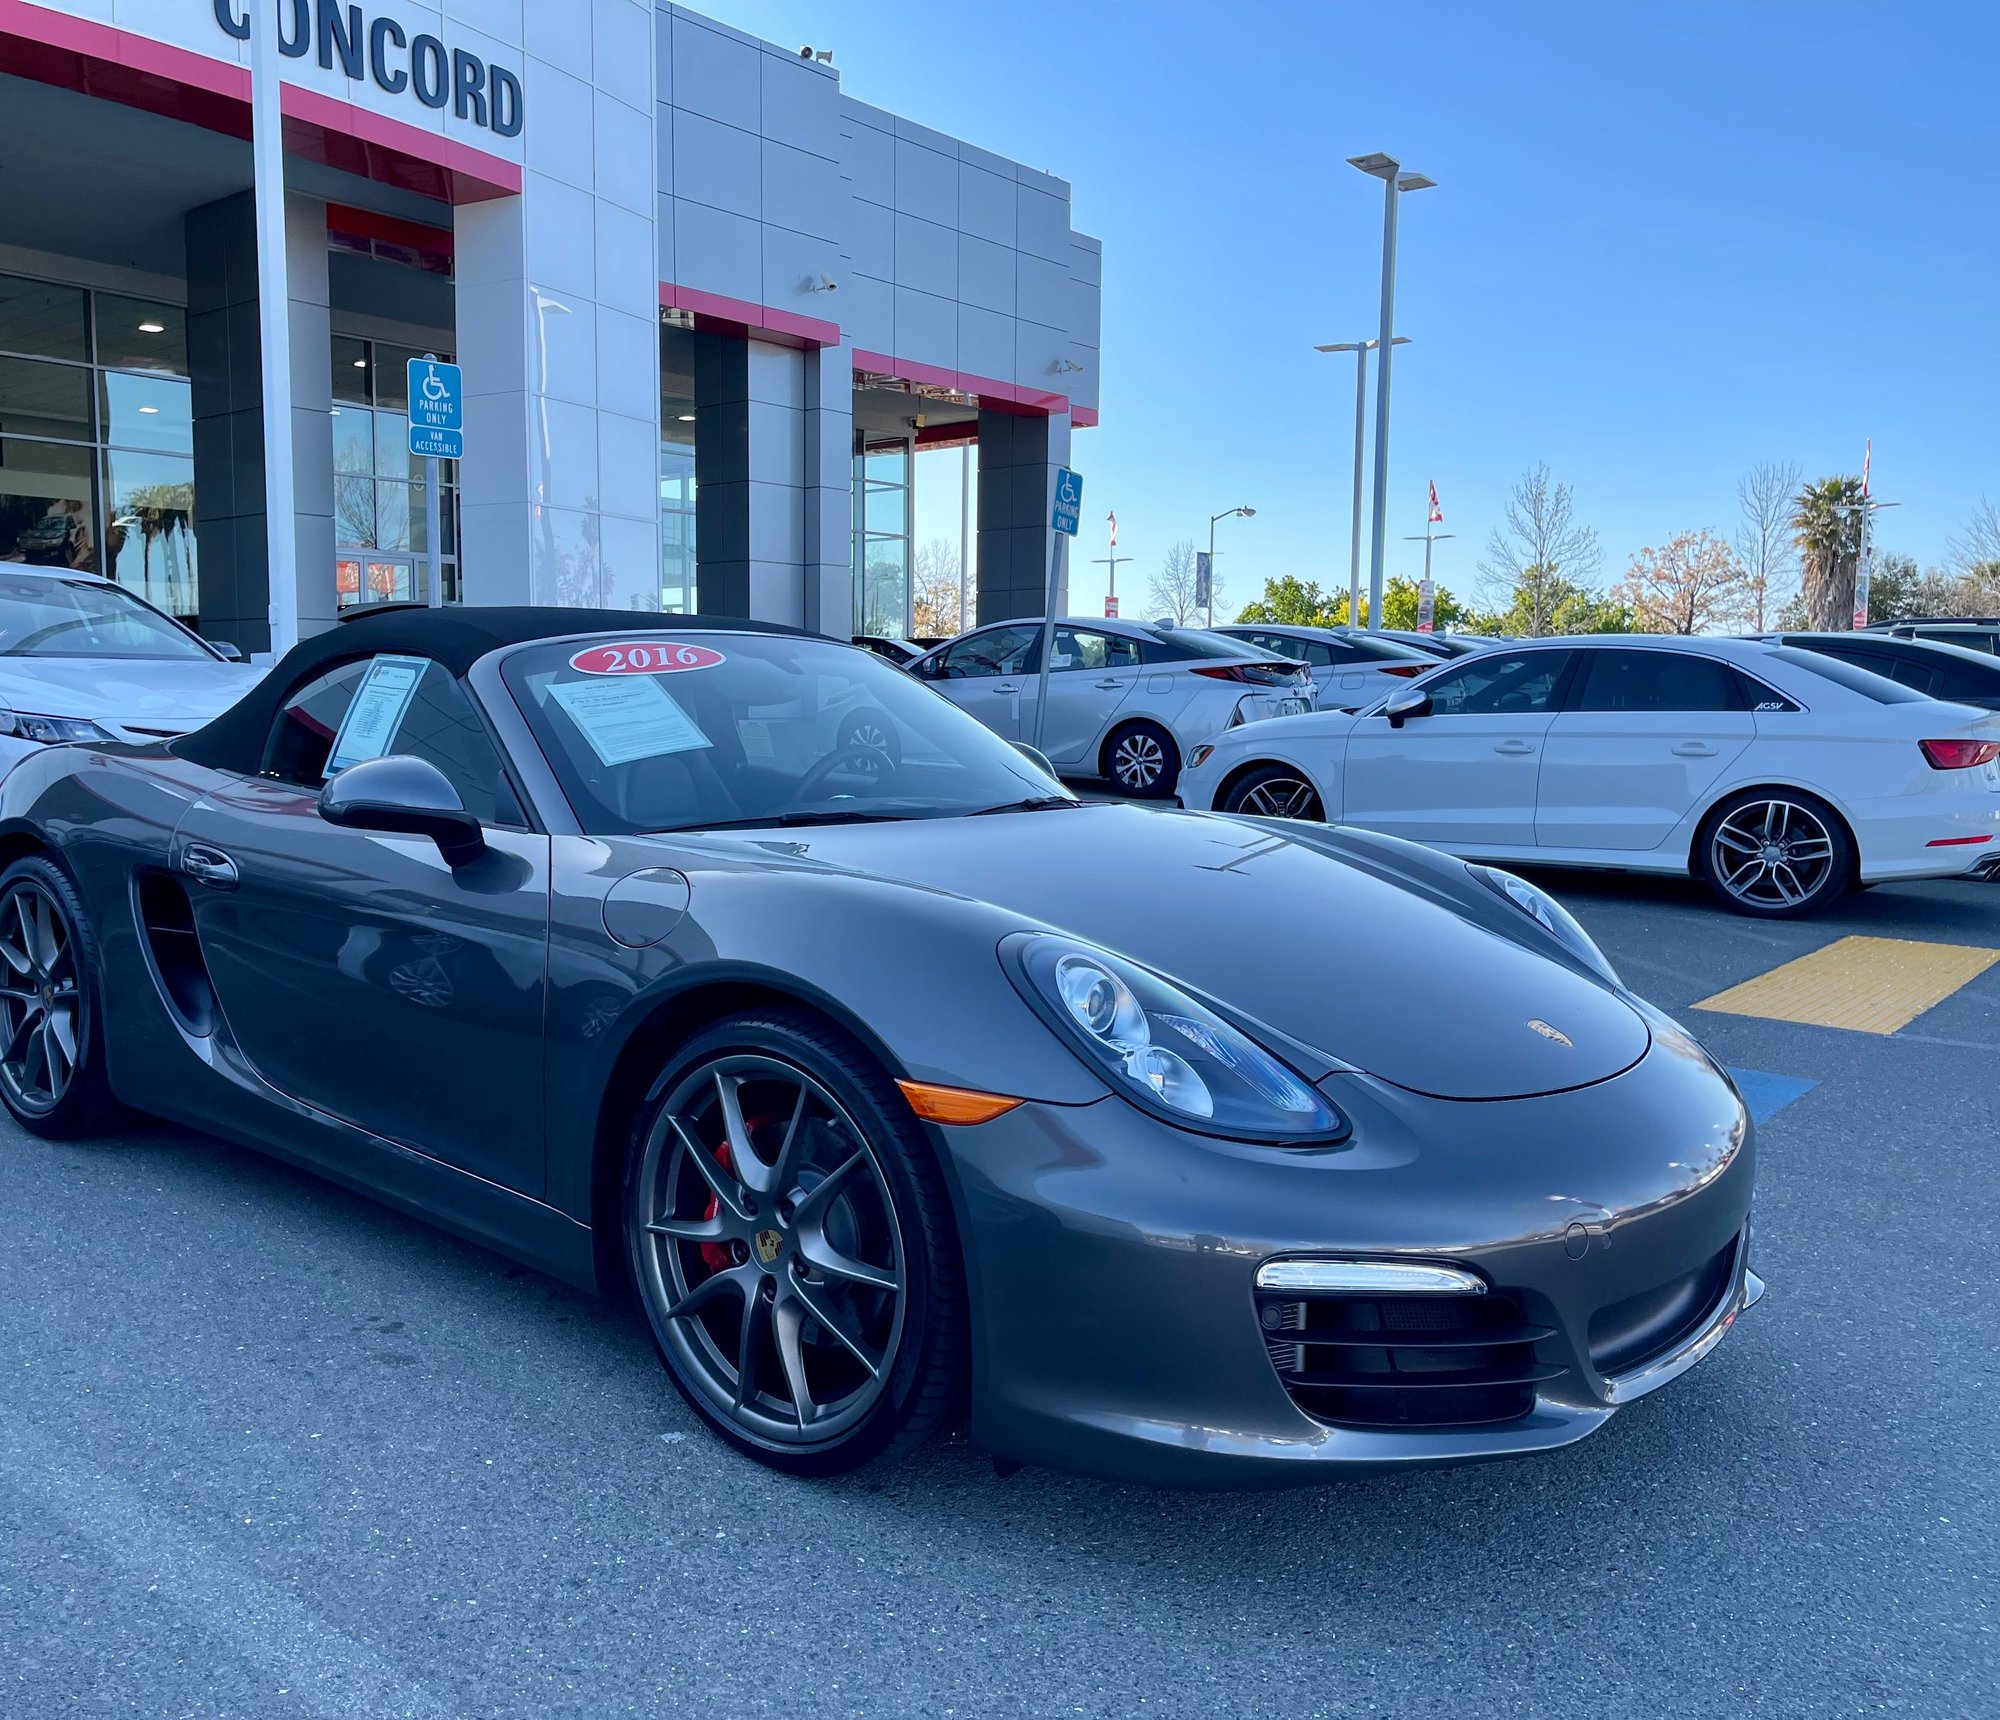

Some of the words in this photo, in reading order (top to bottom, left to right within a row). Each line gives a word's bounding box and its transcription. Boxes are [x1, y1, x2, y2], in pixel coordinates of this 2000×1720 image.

[419, 399, 453, 413] PARKING
[426, 413, 446, 424] ONLY
[430, 431, 443, 441] VAN
[415, 440, 458, 454] ACCESSIBLE
[1054, 500, 1079, 519] PARKING
[1057, 515, 1073, 531] ONLY
[602, 646, 698, 672] 2016
